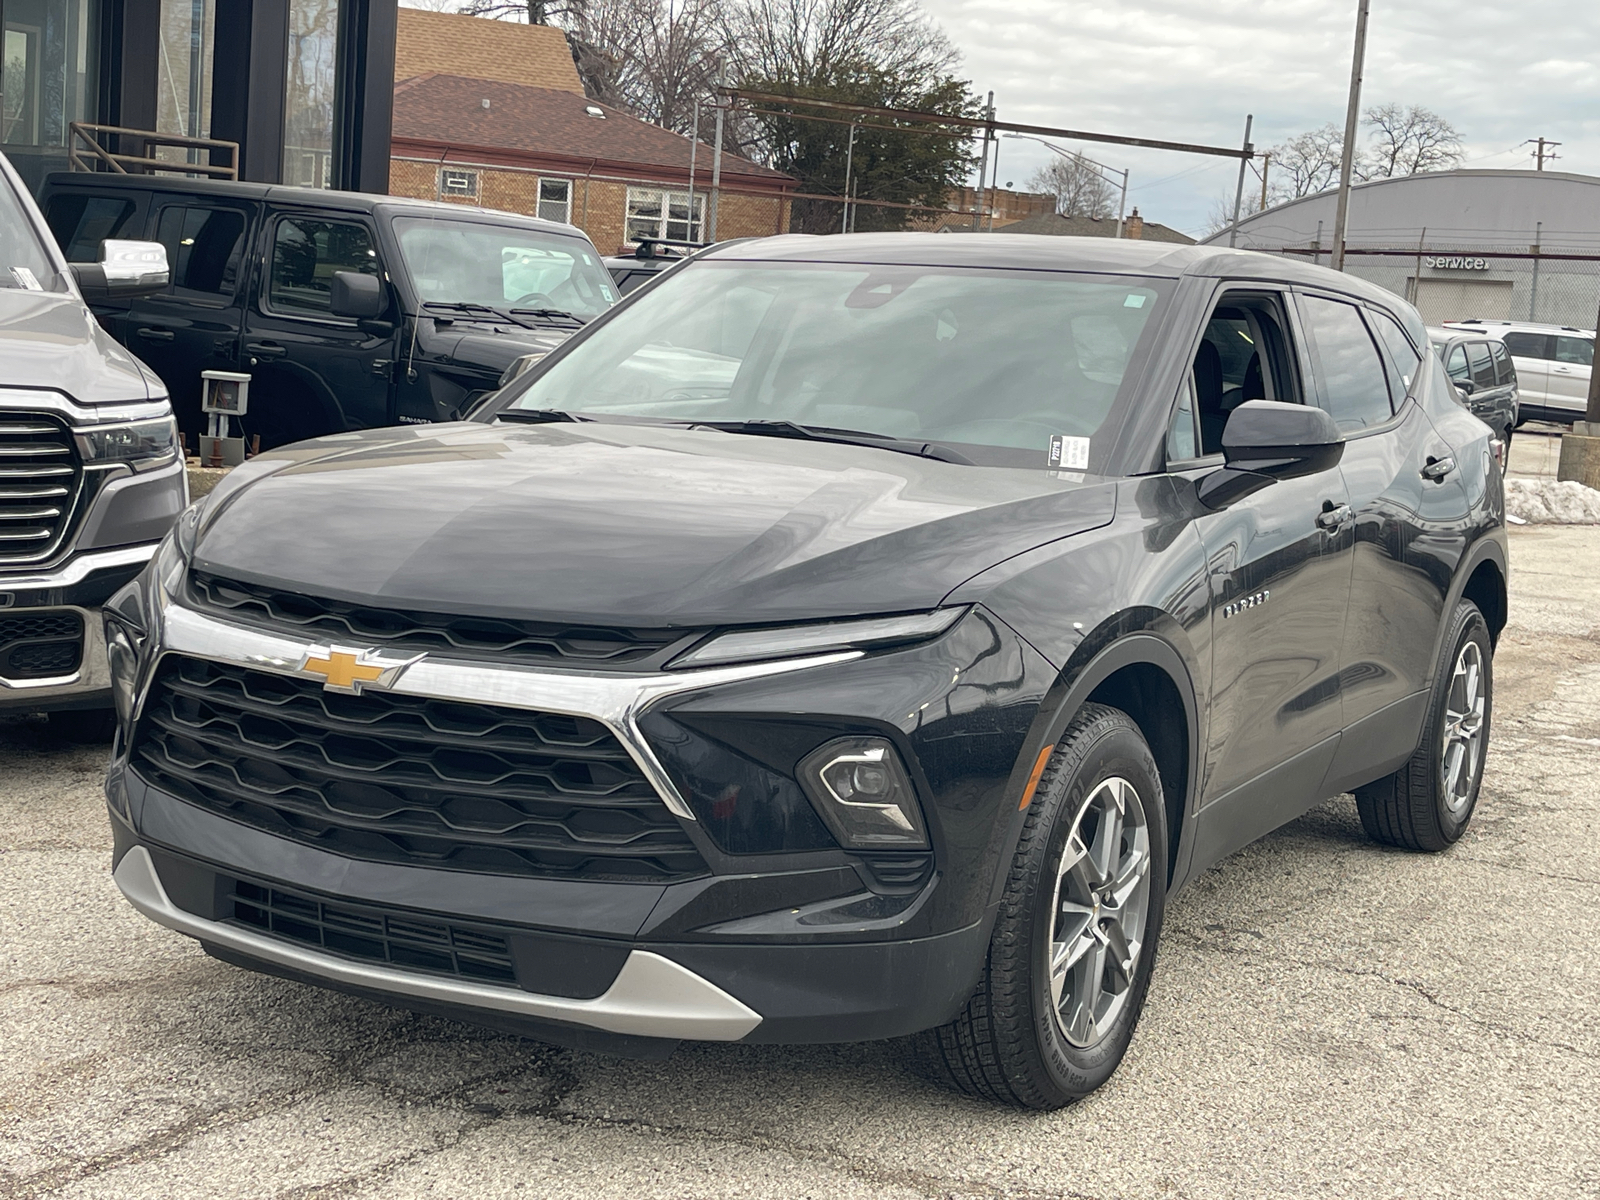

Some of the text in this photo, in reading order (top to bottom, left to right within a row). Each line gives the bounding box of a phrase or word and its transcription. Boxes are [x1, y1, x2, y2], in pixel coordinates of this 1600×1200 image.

[1425, 256, 1485, 269] Service
[399, 416, 432, 424] SAHARA
[1224, 590, 1270, 618] BLAZER
